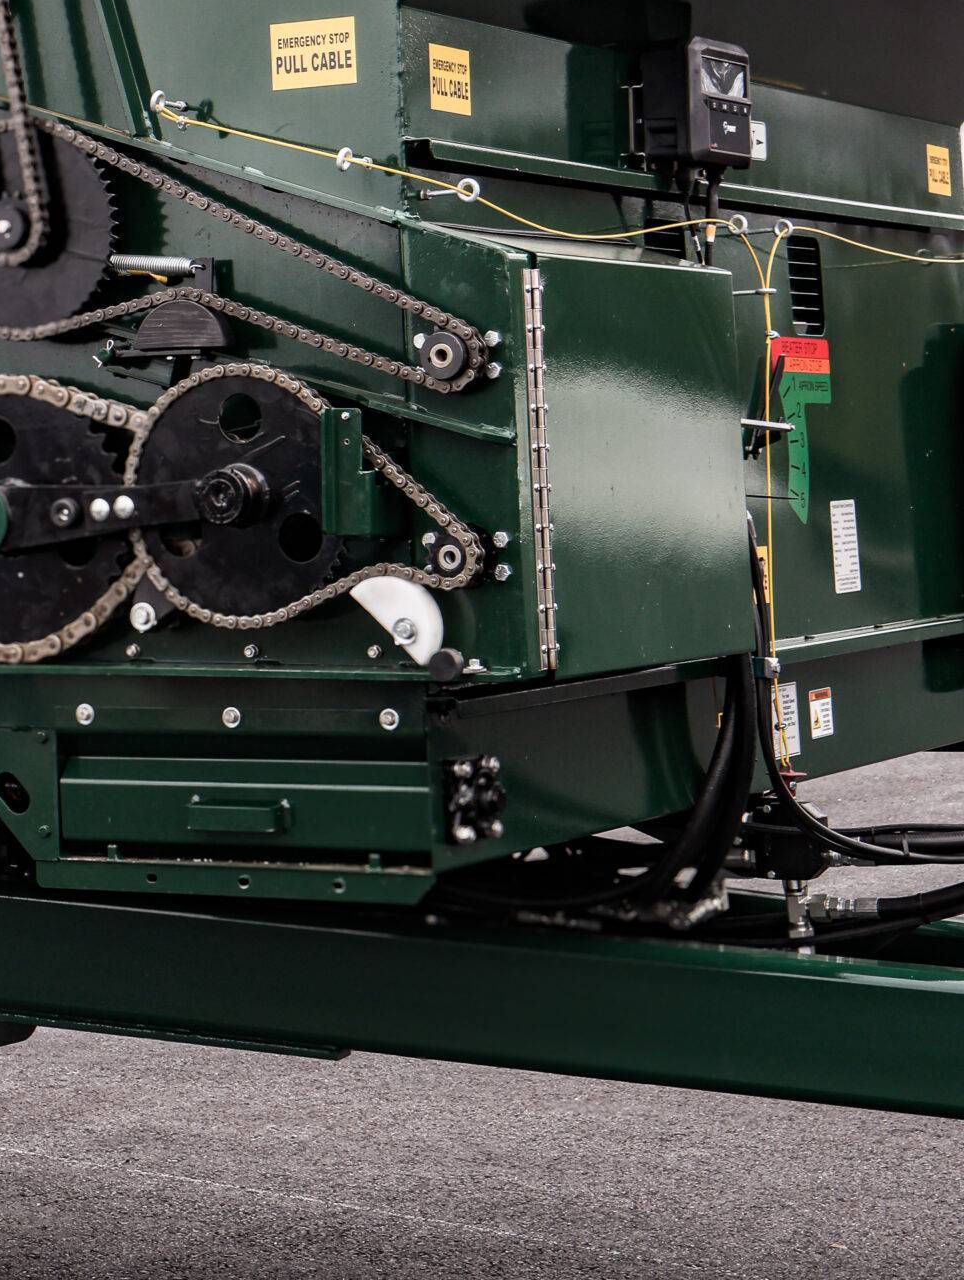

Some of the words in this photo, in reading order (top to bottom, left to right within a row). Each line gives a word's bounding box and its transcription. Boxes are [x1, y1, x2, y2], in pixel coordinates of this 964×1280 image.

[277, 34, 326, 50] EMERGENCY
[329, 31, 350, 44] STOP
[276, 55, 308, 74] PULL
[311, 49, 353, 71] CABLE
[432, 58, 456, 73] EMERGENCY
[457, 63, 468, 75] STOP
[432, 76, 448, 97] PULL
[448, 78, 469, 101] CABLE
[804, 342, 818, 355] STOP
[791, 376, 796, 392] 1
[796, 402, 802, 418] 2
[800, 431, 805, 448] 3
[801, 462, 806, 479] 4
[800, 492, 806, 508] 5
